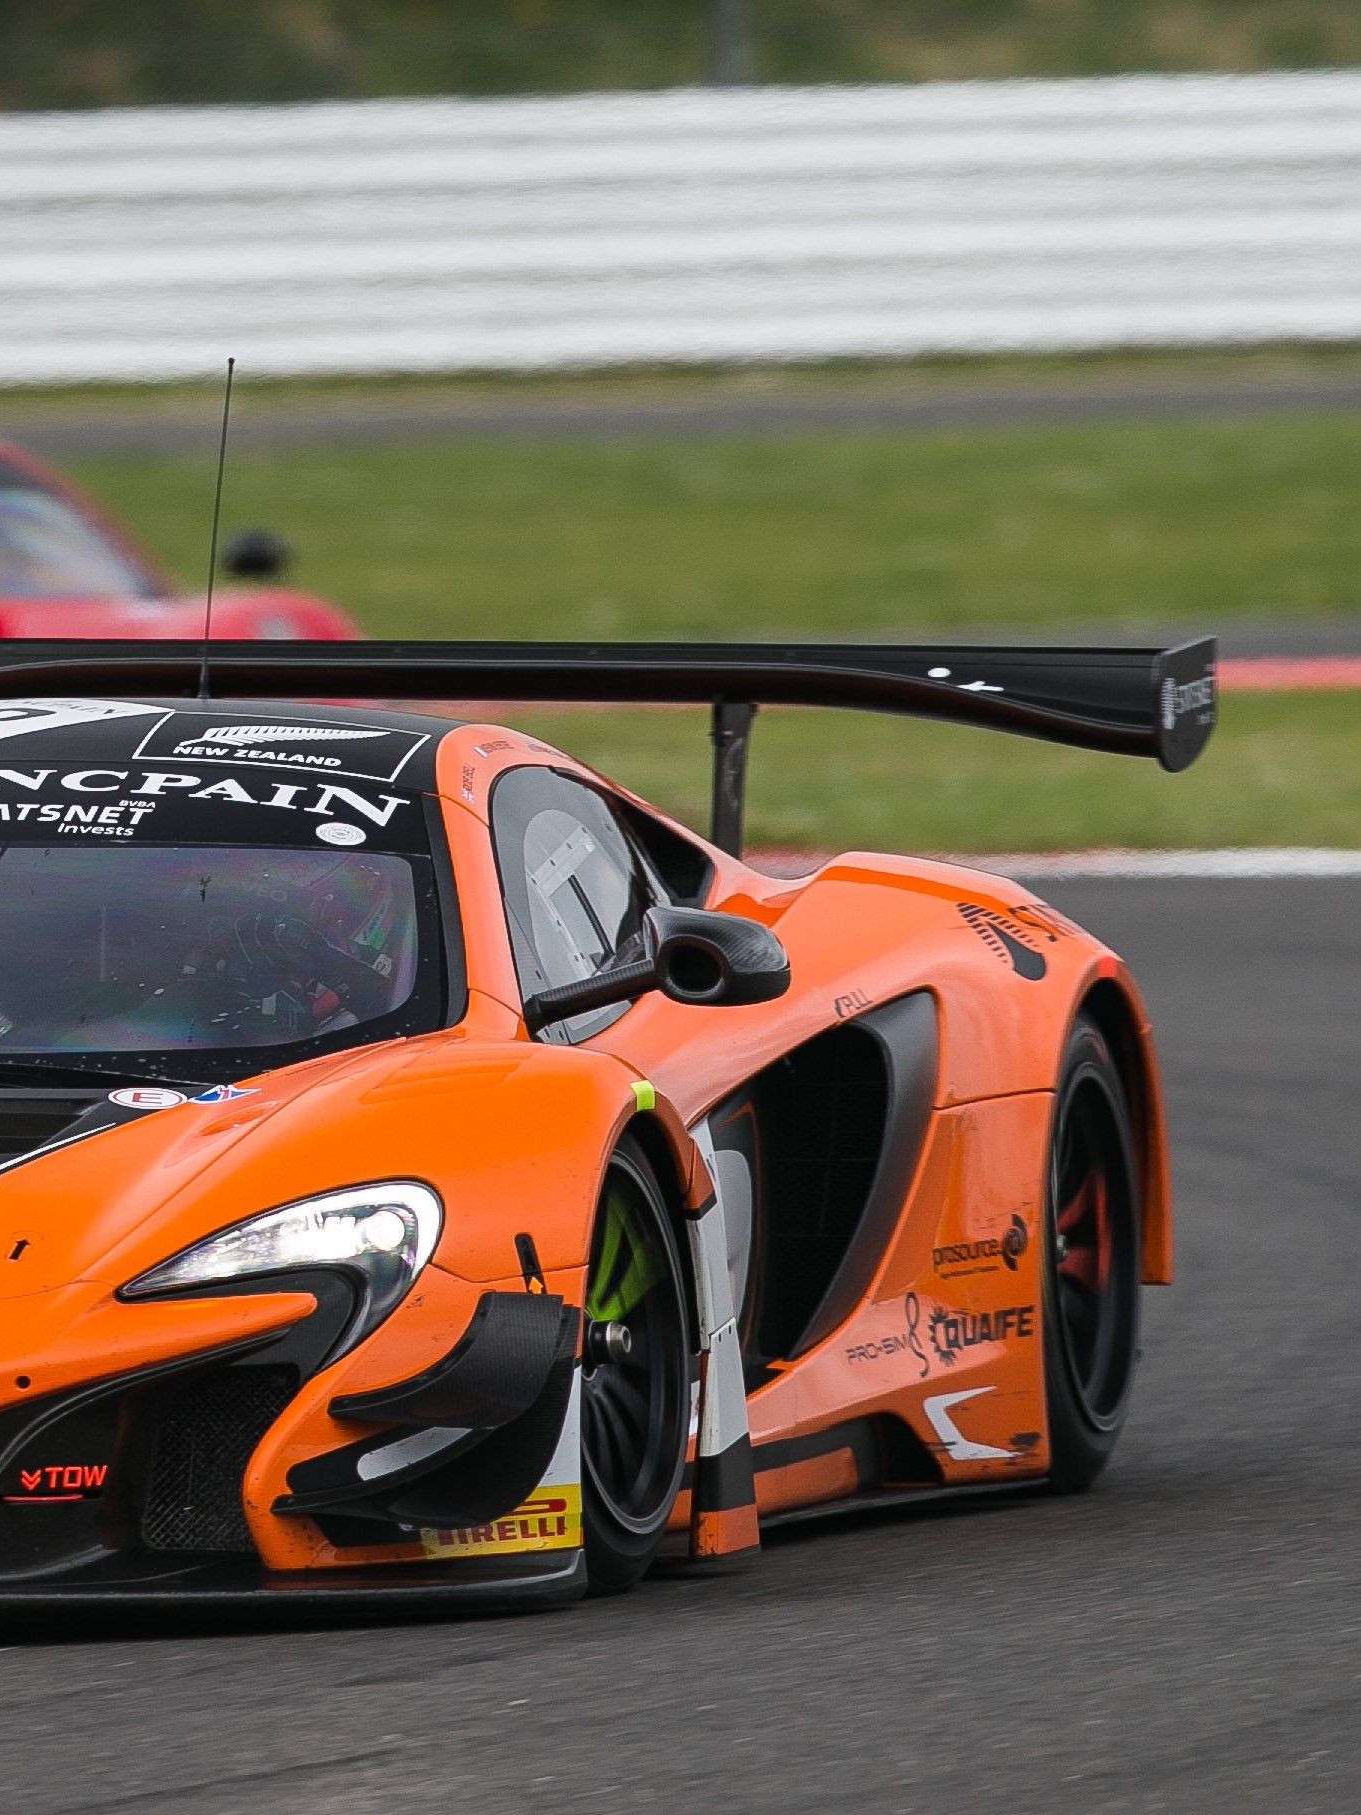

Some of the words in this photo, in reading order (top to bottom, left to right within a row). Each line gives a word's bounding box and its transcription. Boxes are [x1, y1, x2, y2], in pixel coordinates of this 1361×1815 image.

[173, 745, 229, 756] NEW
[233, 749, 342, 767] ZEALAND
[57, 823, 135, 837] Invests
[46, 1465, 108, 1489] TOW
